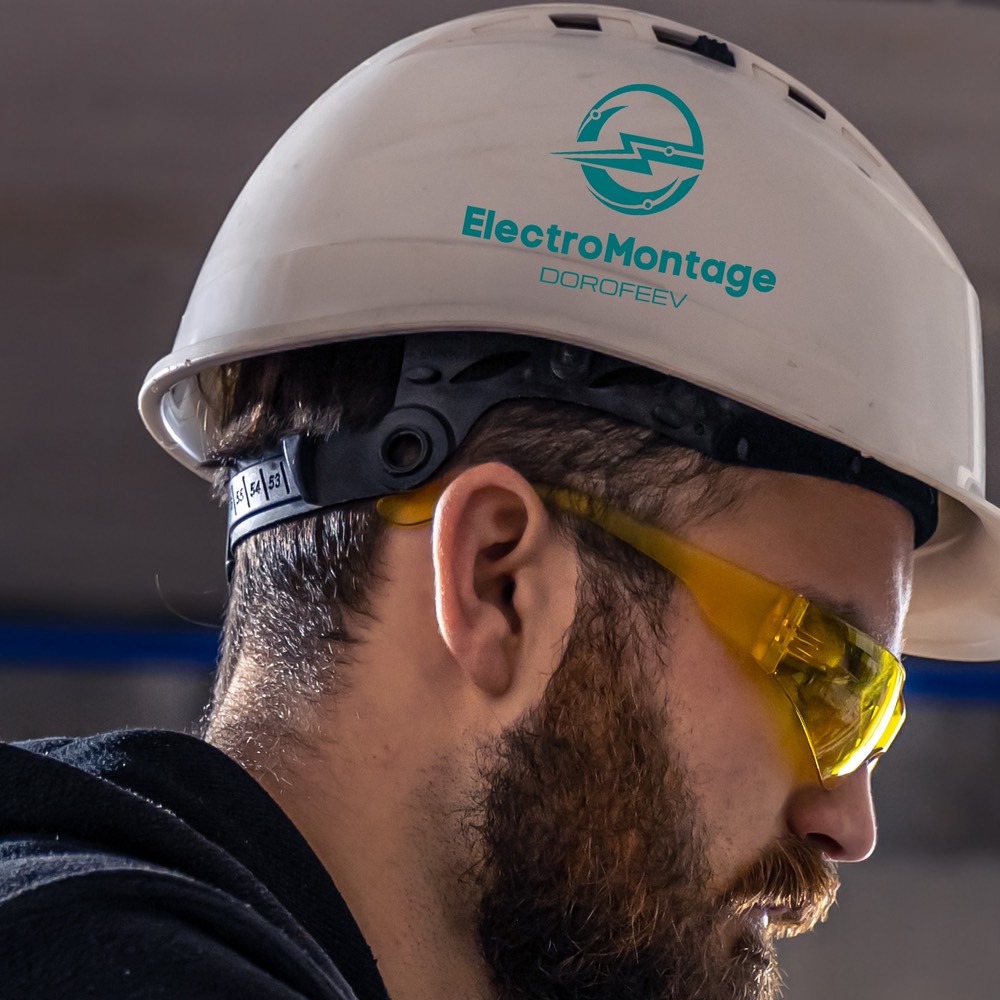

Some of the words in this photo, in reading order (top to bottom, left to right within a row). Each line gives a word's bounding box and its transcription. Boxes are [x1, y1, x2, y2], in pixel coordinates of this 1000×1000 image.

[461, 205, 777, 298] ElectroMontage
[539, 266, 687, 308] DOROFEEV
[250, 480, 261, 498] 54
[268, 472, 281, 490] 53
